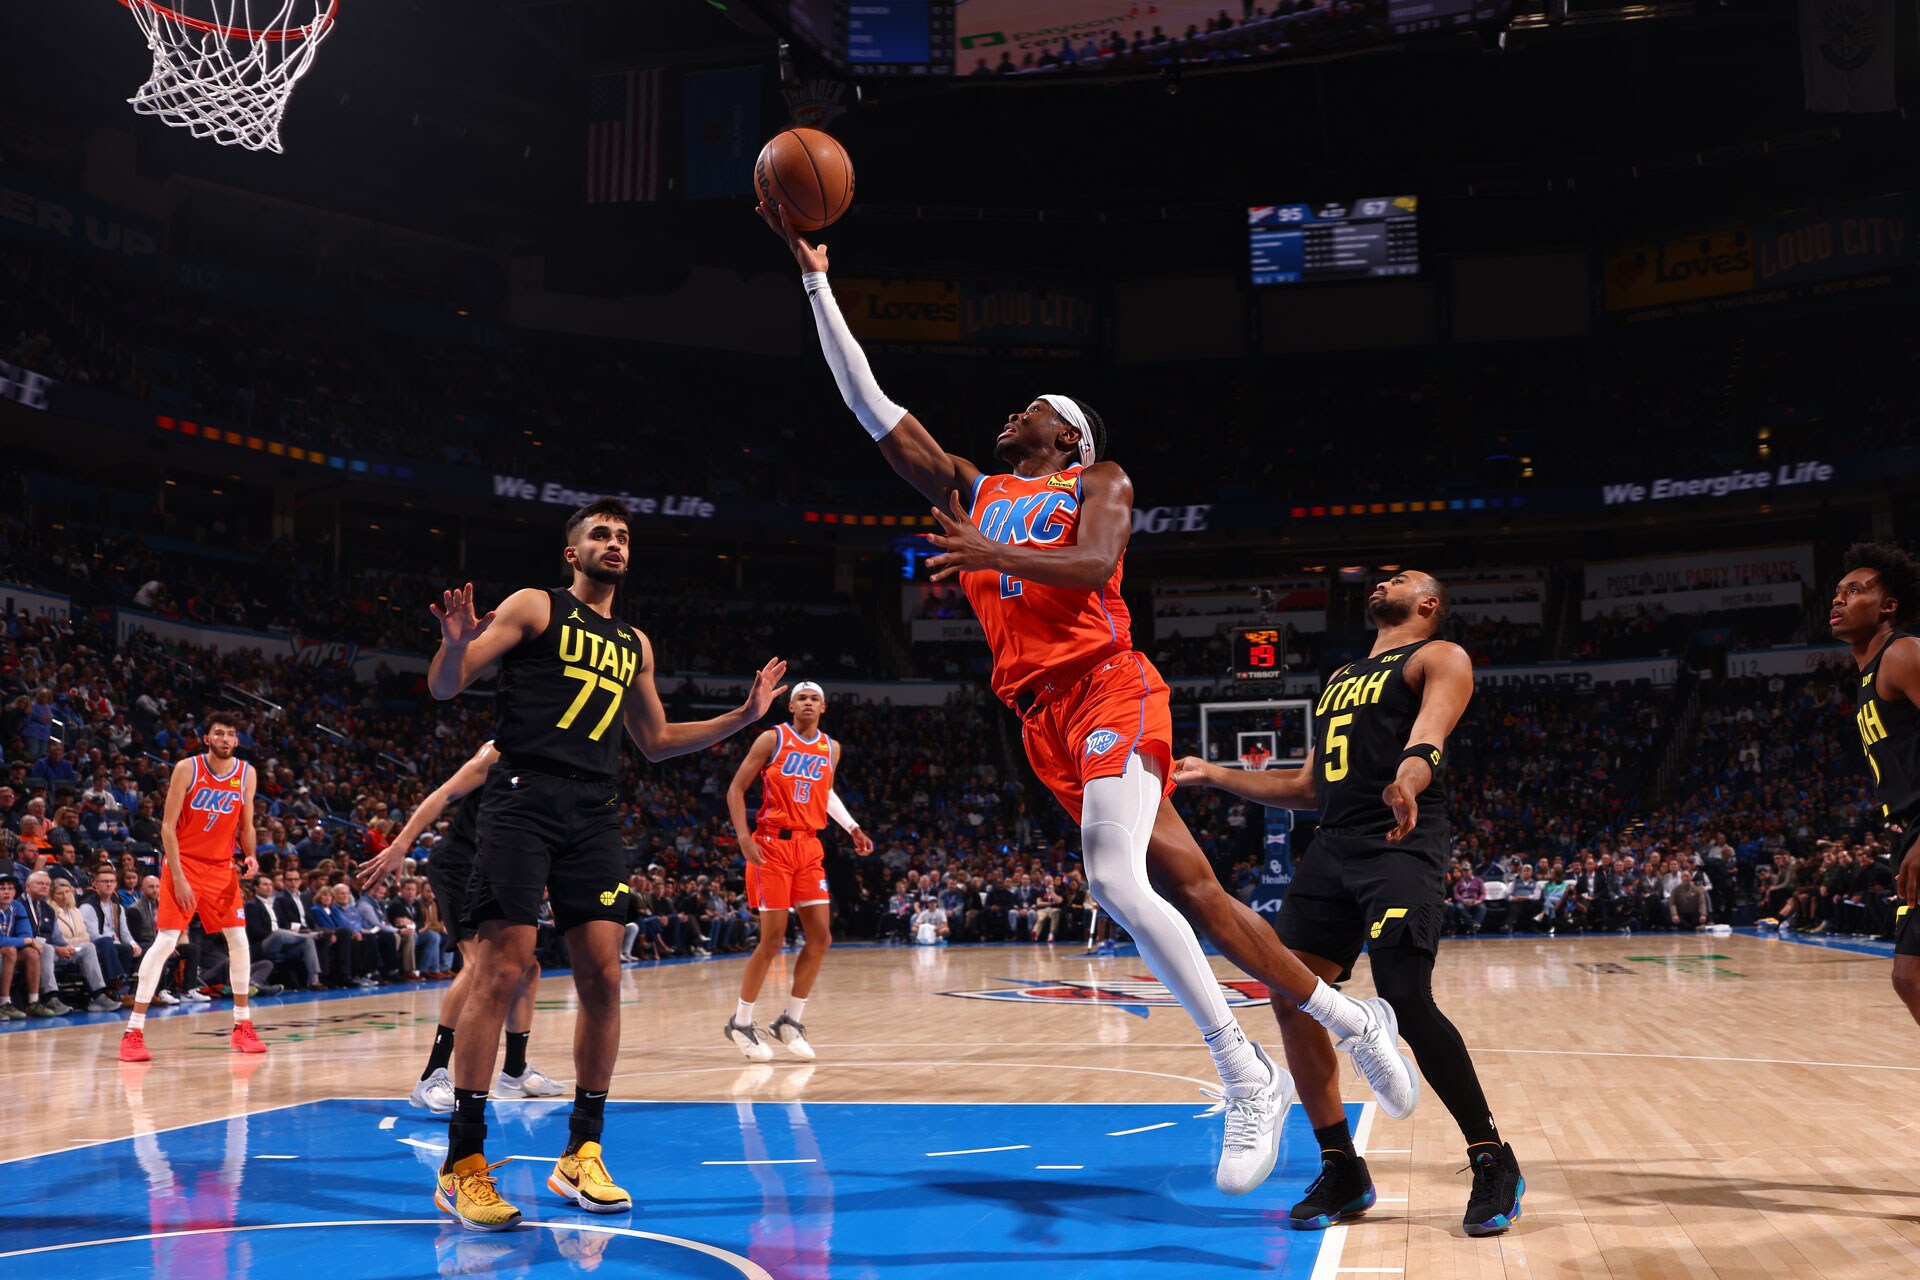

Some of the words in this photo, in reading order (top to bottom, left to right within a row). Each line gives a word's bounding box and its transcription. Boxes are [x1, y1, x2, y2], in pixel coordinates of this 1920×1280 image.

[1013, 14, 1136, 42] paycom
[1019, 29, 1109, 50] center
[1277, 208, 1303, 223] 95
[1362, 201, 1388, 217] 67
[84, 215, 156, 256] UP
[1760, 222, 1833, 280] LOUD
[1842, 216, 1904, 257] CITY
[968, 290, 1032, 336] LOUD
[1039, 291, 1094, 336] CITY
[493, 474, 538, 500] We
[661, 495, 716, 518] Life
[1603, 482, 1647, 505] We
[1650, 469, 1772, 499] Energize
[1776, 460, 1834, 486] Life
[979, 491, 1077, 545] OKC
[1608, 576, 1637, 592] POST
[1655, 570, 1681, 588] OAK
[1685, 566, 1730, 583] PARTY
[1734, 560, 1797, 580] TERRACE
[1721, 594, 1742, 606] POST
[1755, 591, 1773, 604] OAK
[559, 625, 637, 687] UTAH
[1730, 659, 1758, 676] 112
[1248, 671, 1280, 679] TISSOT
[1475, 672, 1593, 691] HUNDER
[556, 665, 624, 741] 77
[1315, 669, 1392, 717] UTAH
[1087, 733, 1111, 755] OKC
[1325, 712, 1353, 782] 5
[781, 751, 828, 780] OKC
[190, 787, 240, 814] OKC
[794, 779, 812, 804] 13
[203, 812, 219, 831] 7
[1262, 875, 1291, 885] Health
